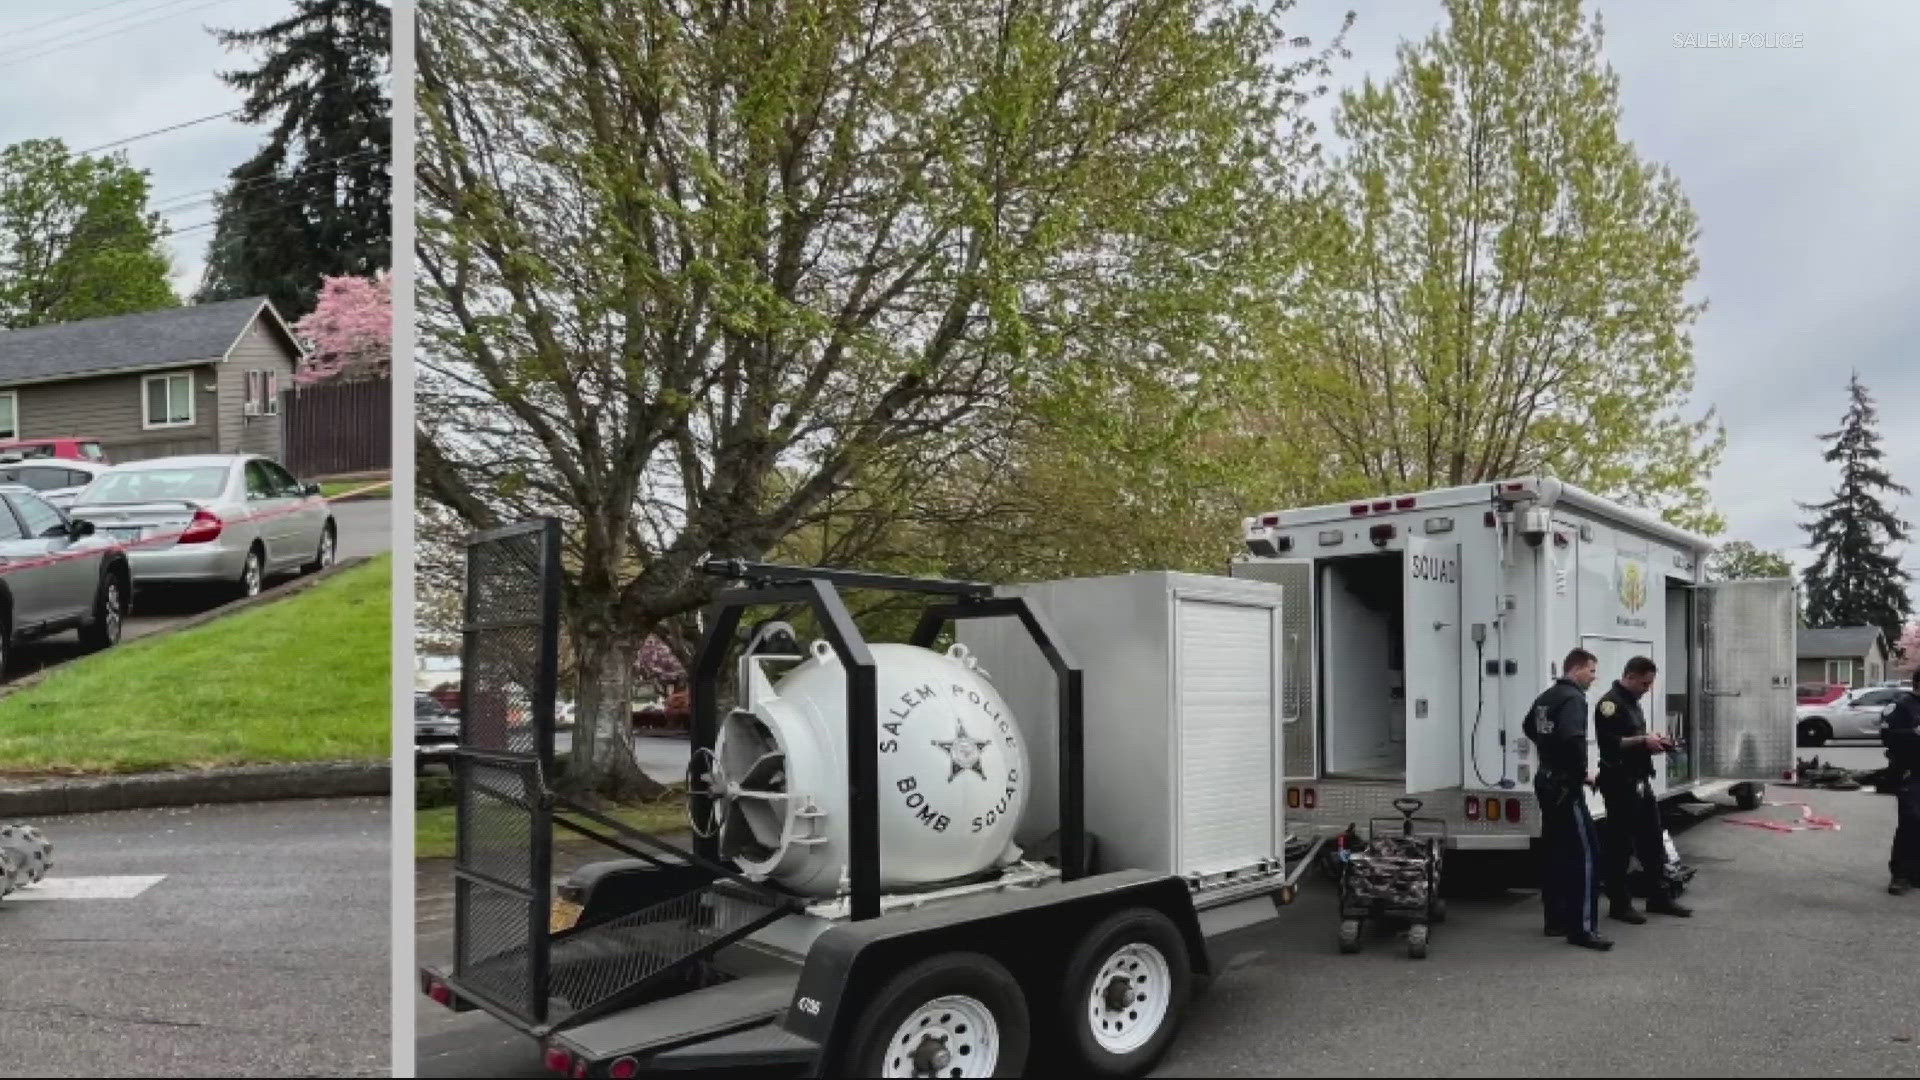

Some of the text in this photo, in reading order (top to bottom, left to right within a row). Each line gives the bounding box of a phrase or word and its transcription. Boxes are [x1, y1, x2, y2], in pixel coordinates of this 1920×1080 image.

[1412, 555, 1456, 583] SQUAD
[880, 684, 1017, 753] SALEM POLICE
[897, 769, 1018, 833] BOMB SQUAD
